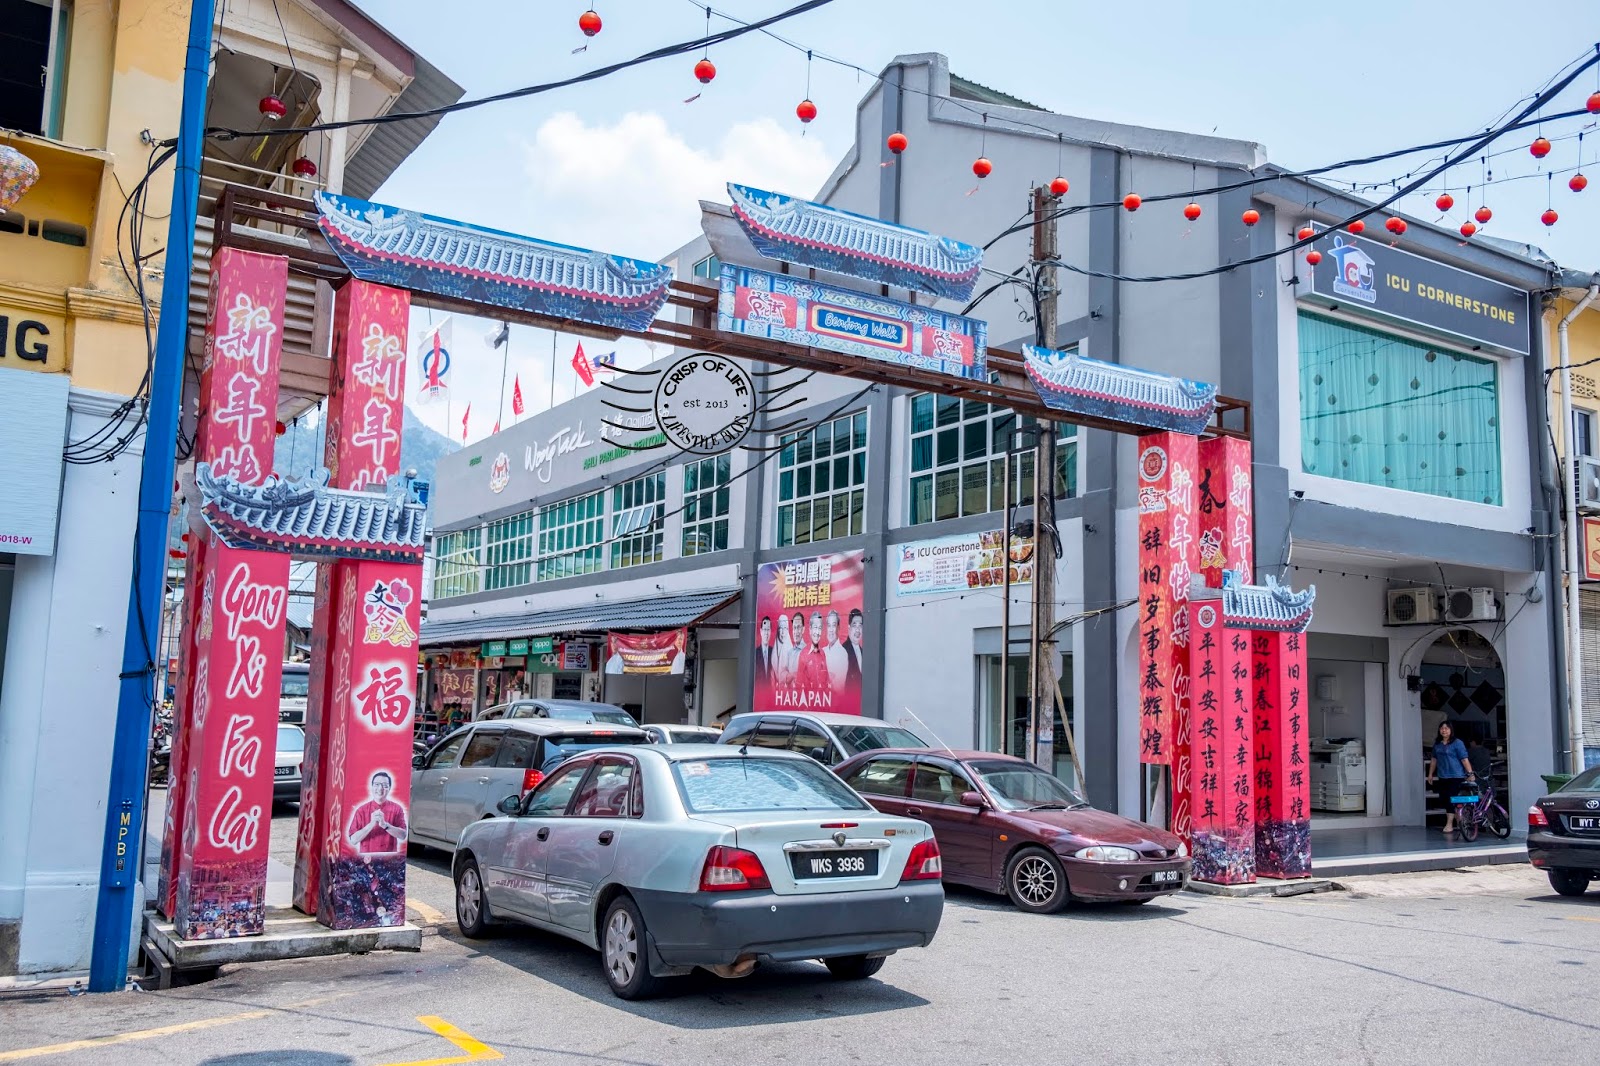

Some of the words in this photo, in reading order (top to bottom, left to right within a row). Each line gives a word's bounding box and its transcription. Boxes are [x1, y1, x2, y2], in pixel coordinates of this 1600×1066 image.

[1386, 273, 1410, 292] ICU
[1417, 283, 1515, 325] CORNERSTONE
[0, 315, 50, 364] G
[824, 312, 869, 337] Bentong
[871, 322, 899, 341] Walk
[1198, 468, 1226, 515] 春
[0, 534, 33, 545] 018-W
[917, 546, 931, 558] ICU
[931, 542, 981, 556] Cornerstone
[783, 560, 832, 585] 告别黑暗
[221, 562, 286, 640] Gong
[534, 641, 550, 649] oppo
[225, 634, 267, 699] Xi
[356, 667, 412, 727] 福
[775, 688, 832, 709] HARAPAN
[219, 713, 262, 778] Fa
[1198, 631, 1218, 828] 平平安安吉祥年
[1231, 633, 1249, 828] 和和气气幸福家
[1578, 818, 1594, 828] WYT
[810, 858, 833, 874] WKS
[837, 856, 865, 873] 3936
[1166, 870, 1177, 880] 630
